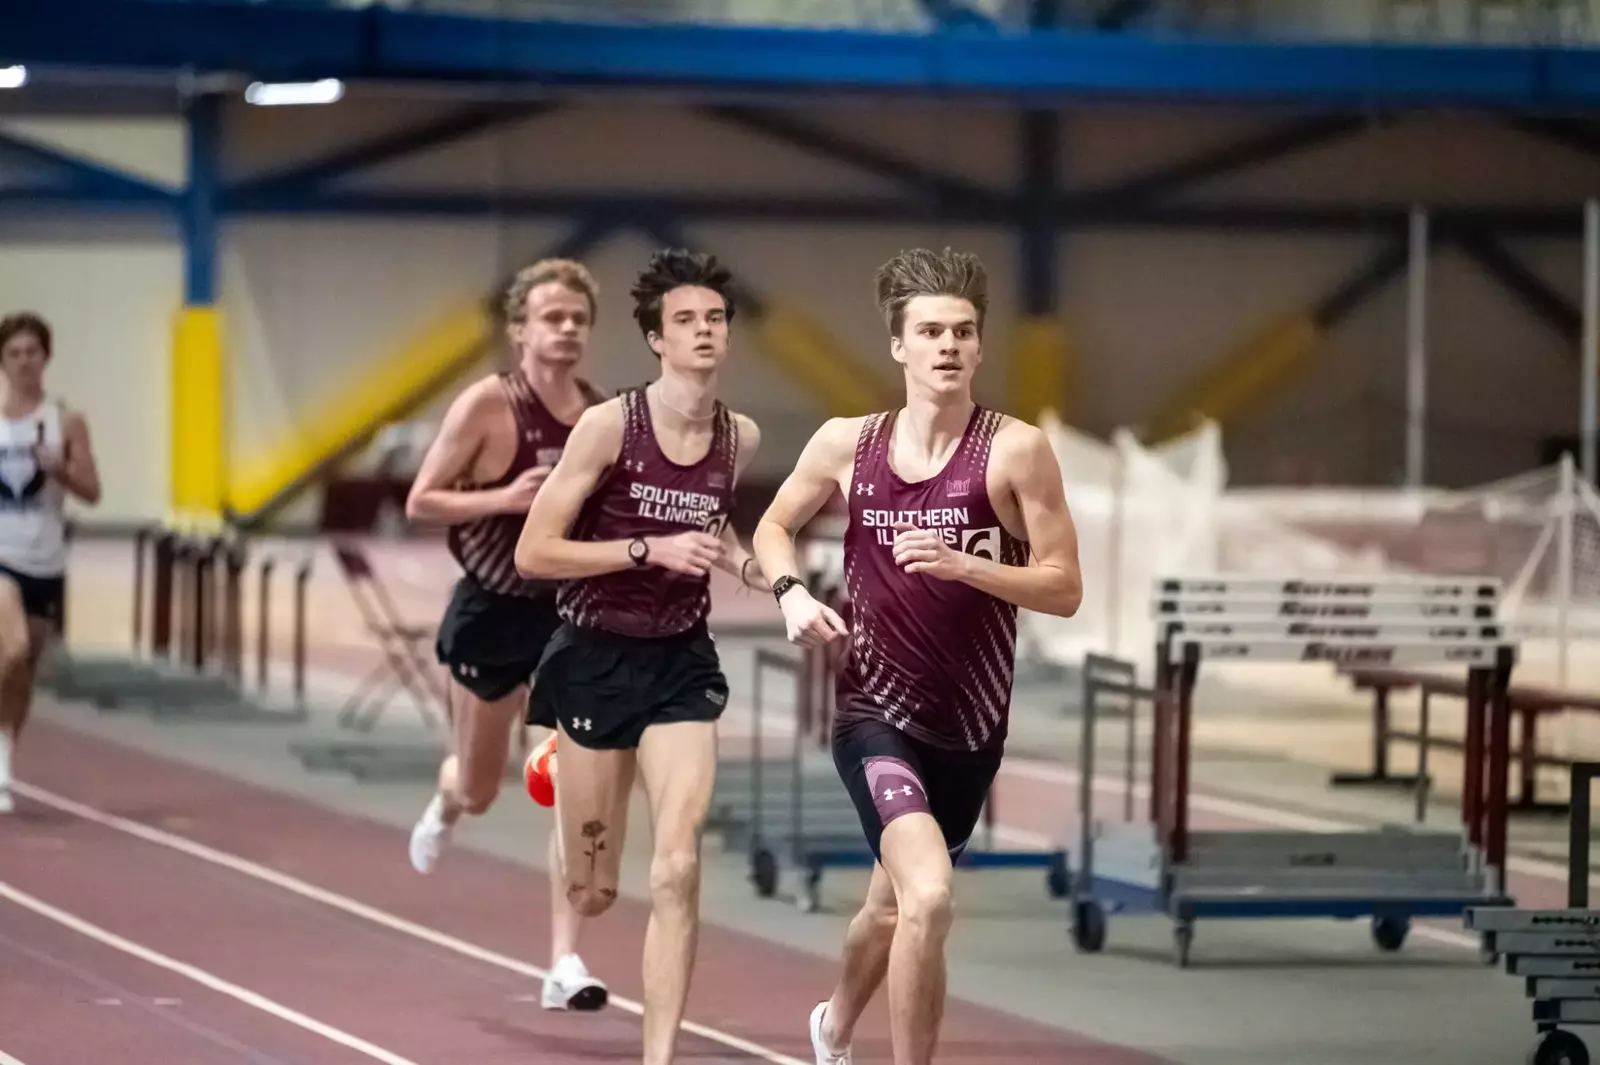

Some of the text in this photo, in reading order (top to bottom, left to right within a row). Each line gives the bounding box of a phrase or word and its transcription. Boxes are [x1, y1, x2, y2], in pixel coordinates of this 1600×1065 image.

[629, 482, 720, 511] SOUTHERN
[638, 501, 709, 526] ILLINOIS
[862, 507, 969, 527] SOUTHERN
